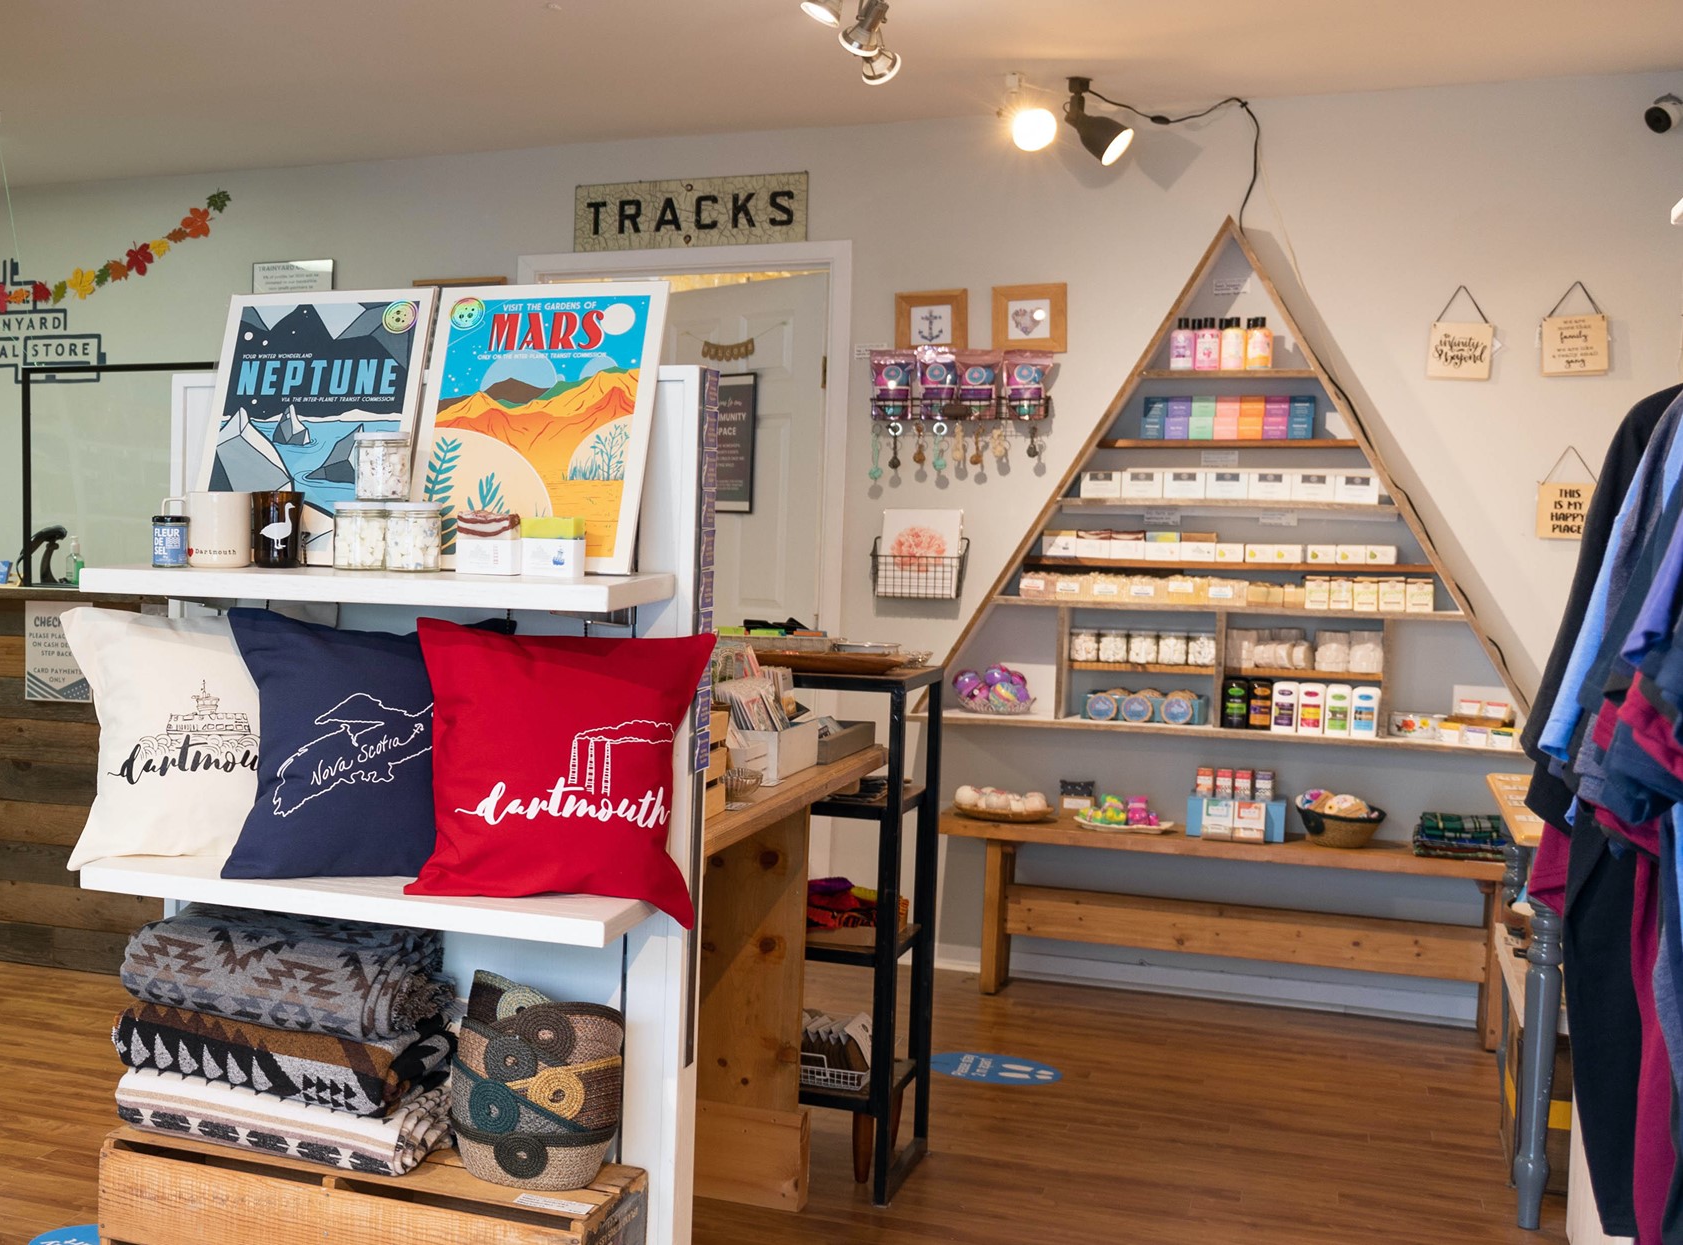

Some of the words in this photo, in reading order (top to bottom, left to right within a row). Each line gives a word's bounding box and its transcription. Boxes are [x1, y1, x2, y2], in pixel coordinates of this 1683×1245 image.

[586, 190, 794, 235] TRACKS
[503, 303, 523, 311] VISIT
[527, 302, 542, 311] THE
[544, 302, 581, 310] GARDENS
[584, 301, 597, 309] OF
[487, 310, 605, 352] MARS
[1560, 330, 1588, 344] family
[32, 342, 90, 357] STORE
[1439, 336, 1479, 353] infinity
[1443, 345, 1487, 369] beyond
[1565, 358, 1585, 369] gang
[236, 358, 399, 395] NEPTUNE
[718, 426, 736, 436] PACE
[1559, 489, 1581, 498] THIS
[1554, 500, 1563, 510] IS
[1567, 500, 1584, 510] MY
[1550, 512, 1585, 522] HAPPY
[154, 528, 180, 537] FLEUR
[1552, 524, 1582, 534] PLACE
[154, 537, 164, 546] DE
[154, 546, 167, 555] SEL
[34, 616, 61, 628] CHEC
[107, 735, 259, 786] dartmou
[311, 755, 354, 788] Nova
[357, 733, 408, 765] Scotia
[455, 776, 672, 829] dartmouth
